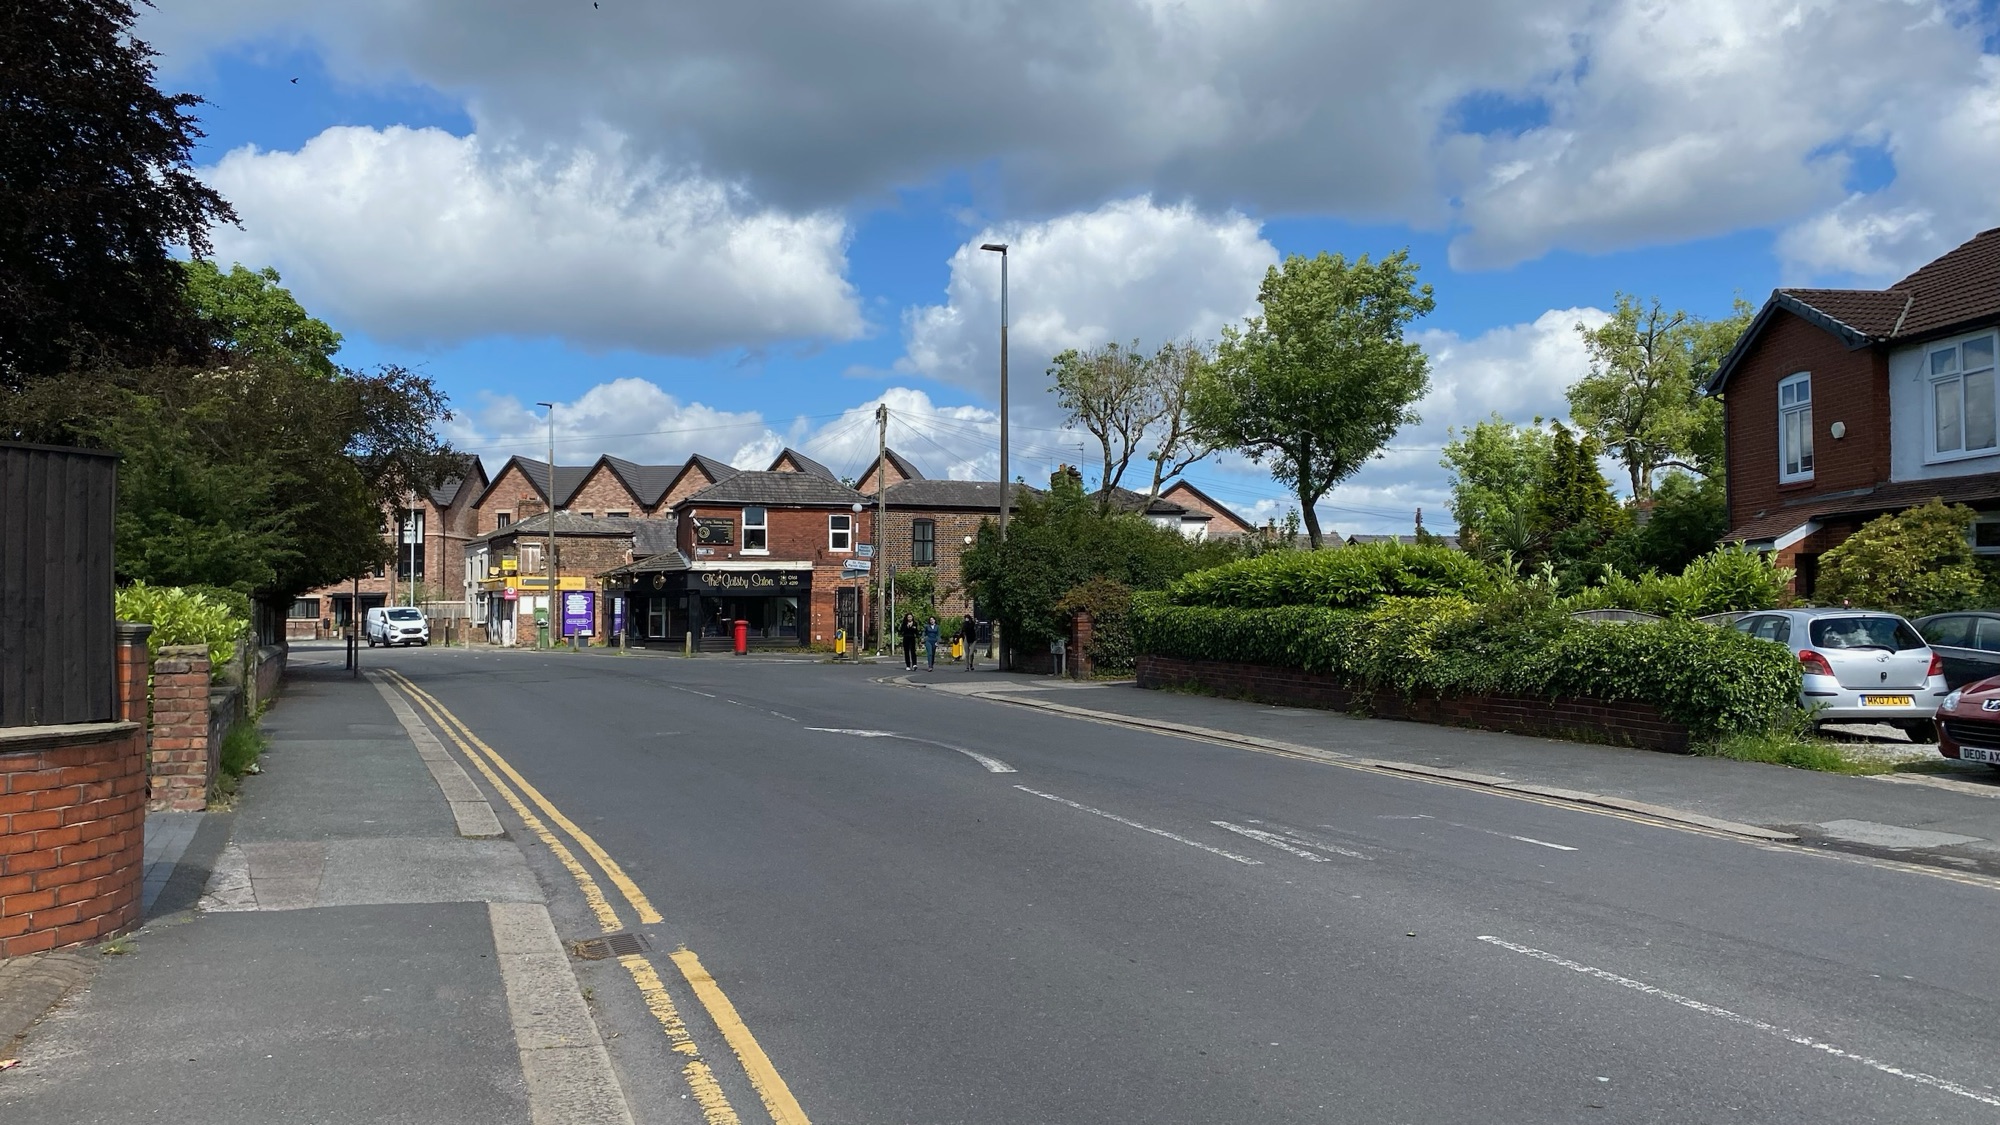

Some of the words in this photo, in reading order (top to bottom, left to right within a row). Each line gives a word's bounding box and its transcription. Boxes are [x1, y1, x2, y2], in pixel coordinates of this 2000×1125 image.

[702, 573, 721, 587] The
[722, 573, 749, 589] Gatsby
[751, 573, 774, 587] Salon
[1867, 697, 1889, 705] MK07
[1893, 696, 1910, 705] CVU
[1964, 748, 1987, 760] DE06
